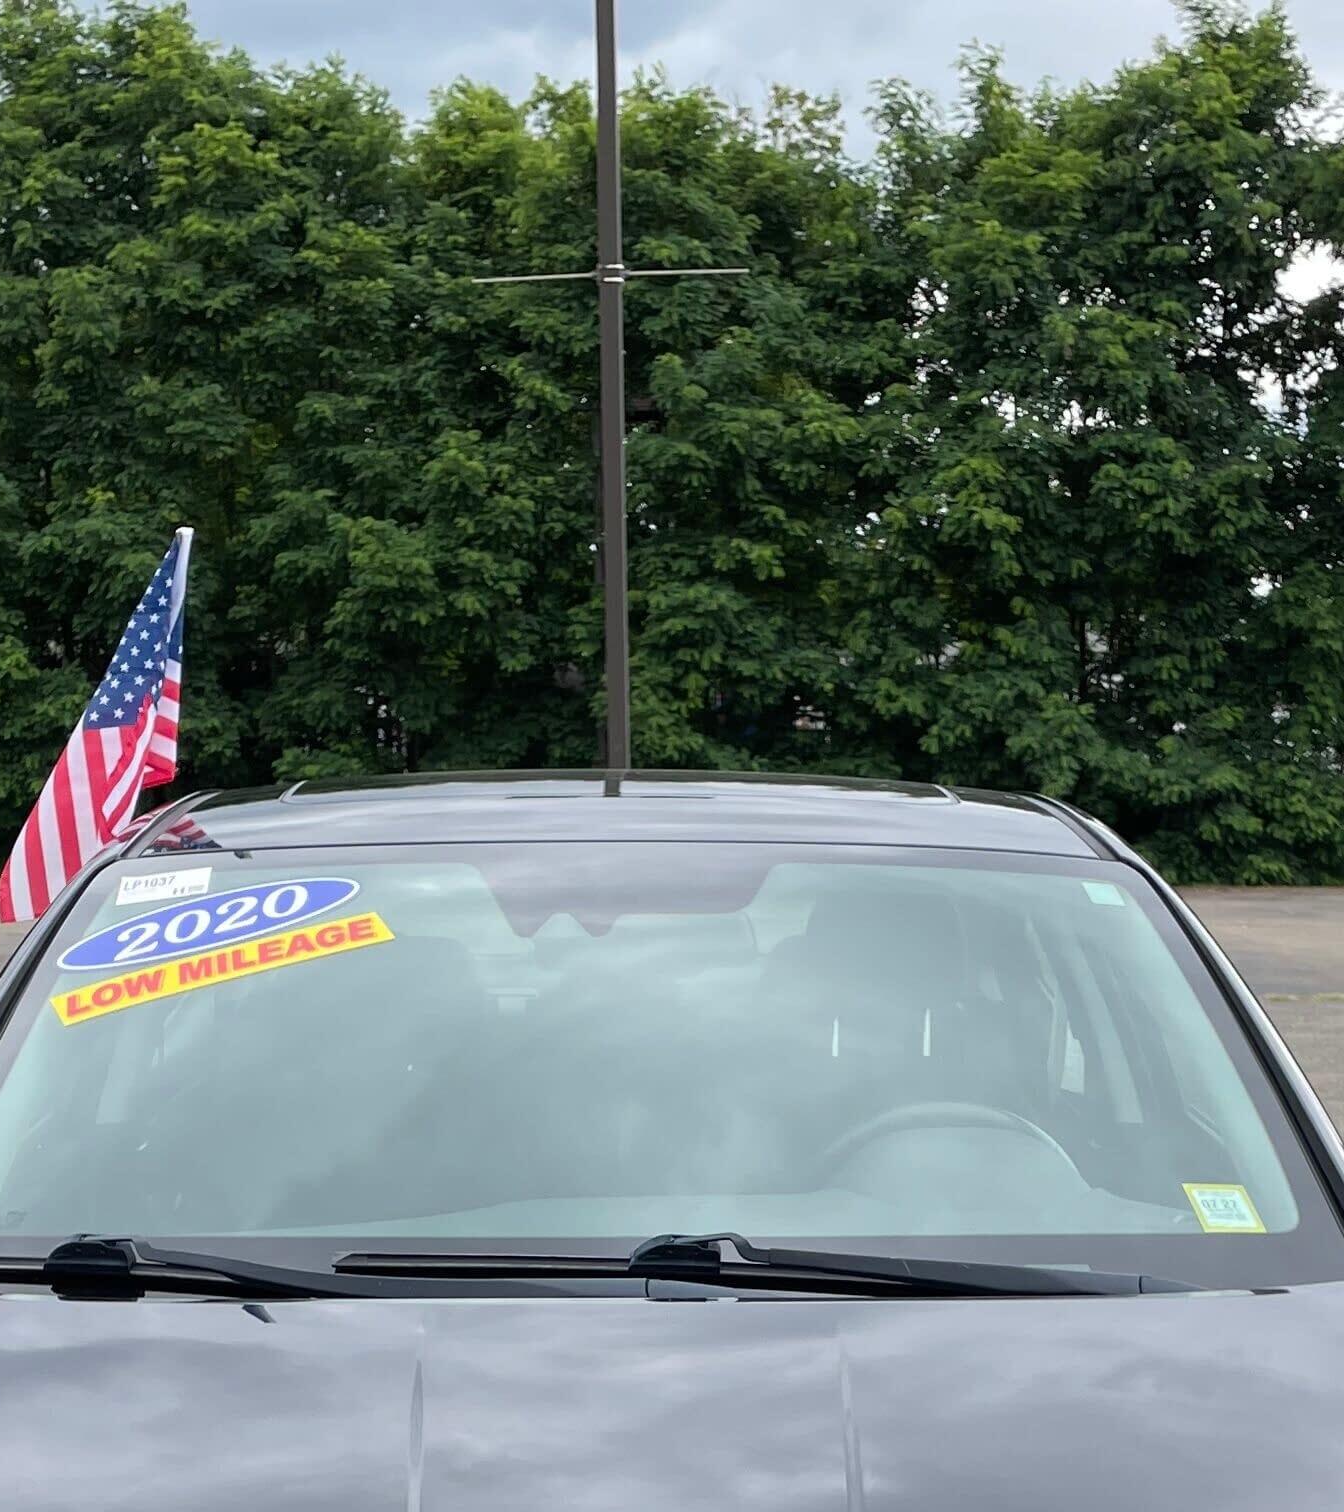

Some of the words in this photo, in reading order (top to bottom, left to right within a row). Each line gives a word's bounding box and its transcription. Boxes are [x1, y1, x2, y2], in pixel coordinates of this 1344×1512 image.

[114, 885, 309, 962] 2020
[66, 970, 165, 1018] LOW
[179, 918, 378, 984] MILEAGE
